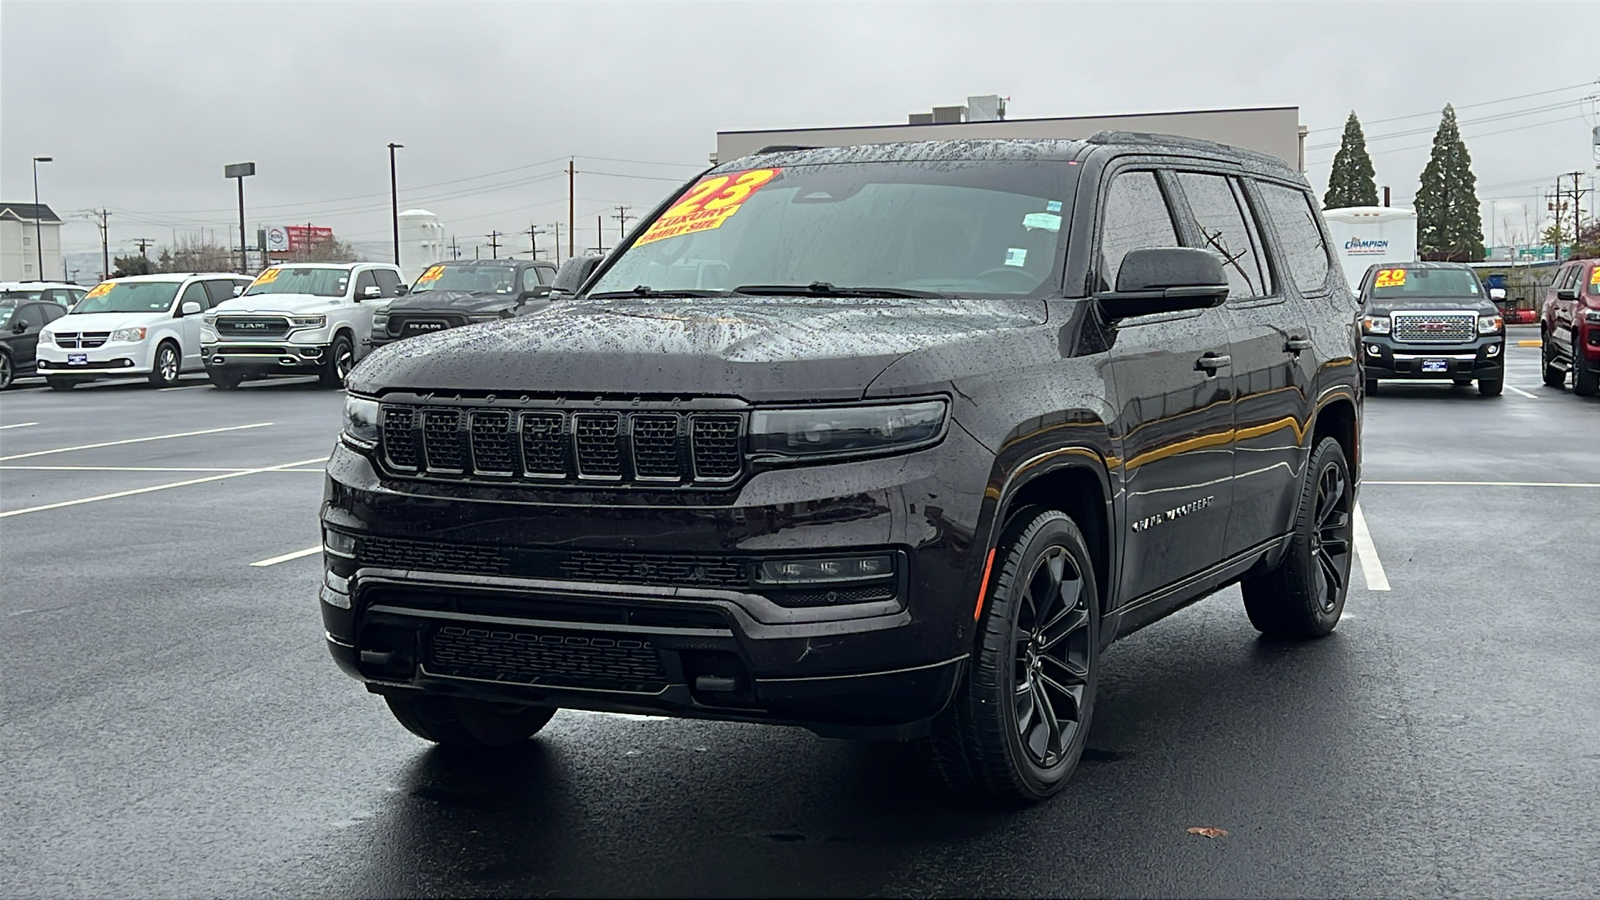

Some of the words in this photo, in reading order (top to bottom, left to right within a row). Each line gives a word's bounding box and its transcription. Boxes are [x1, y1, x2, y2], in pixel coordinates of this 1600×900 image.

[661, 169, 774, 218] 23
[653, 206, 734, 230] LUXURY
[640, 226, 685, 243] FAMILY
[686, 219, 719, 232] SIZE
[1345, 240, 1388, 249] CHAMPION
[1377, 269, 1405, 280] 20
